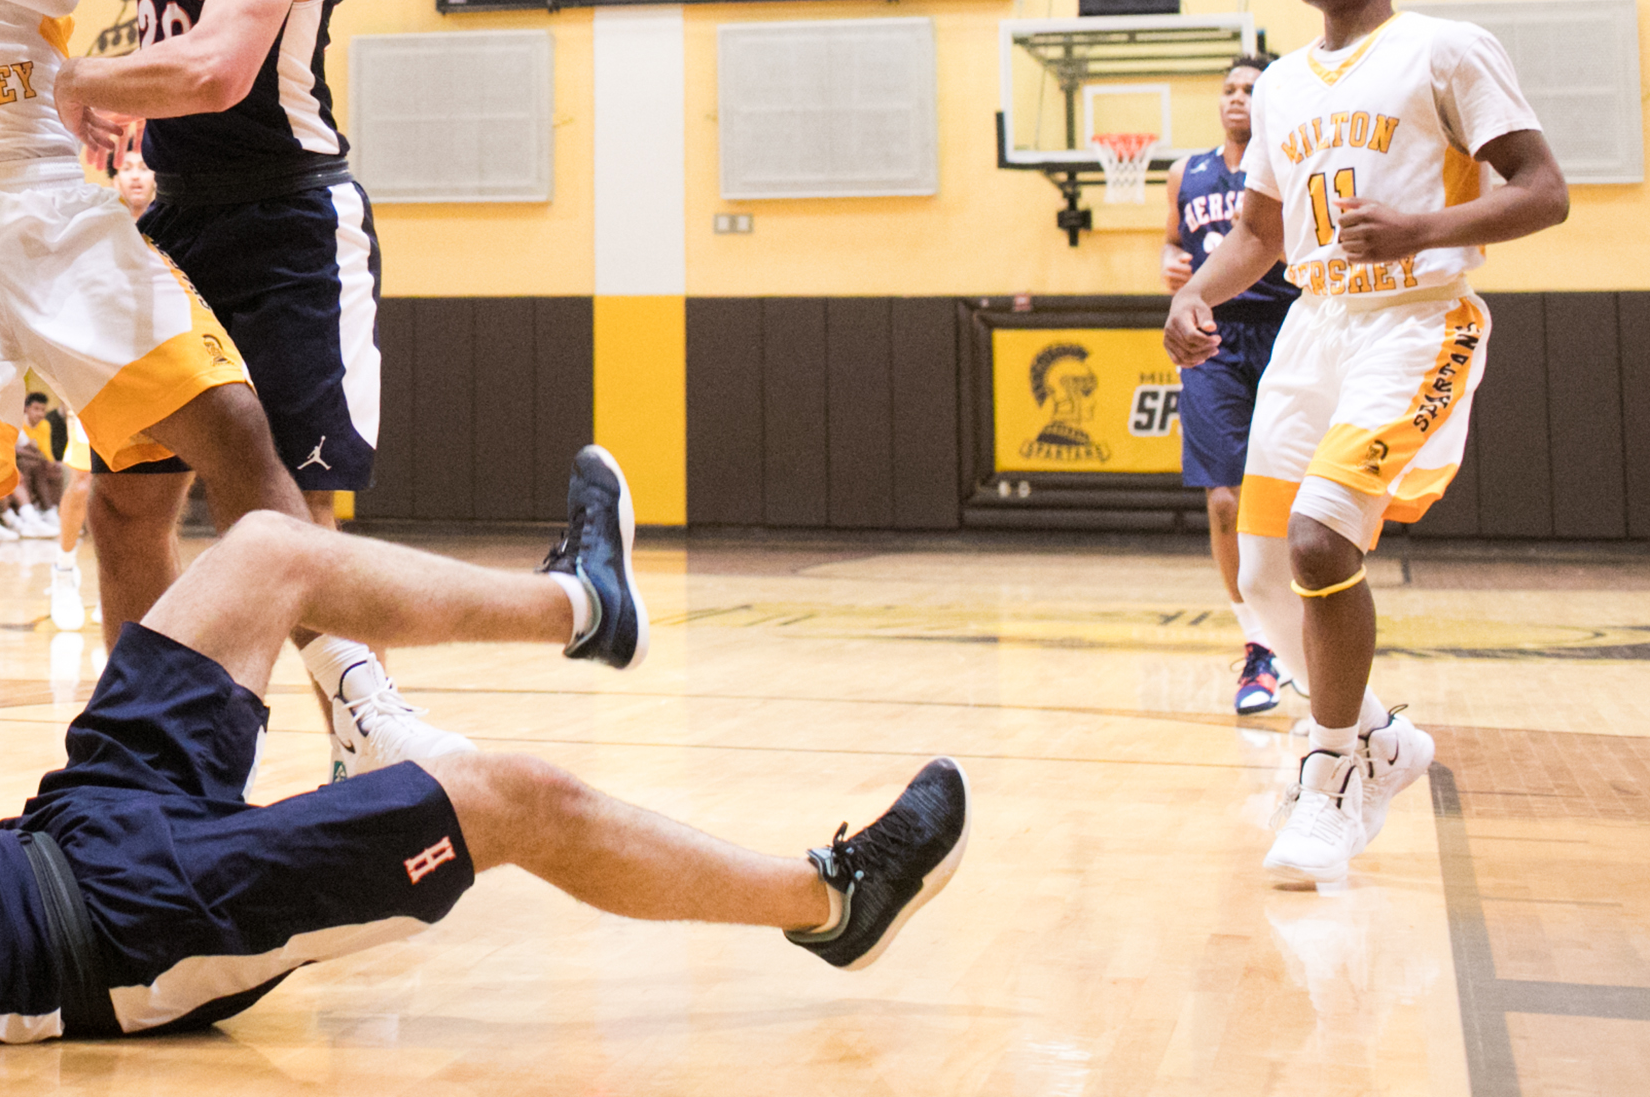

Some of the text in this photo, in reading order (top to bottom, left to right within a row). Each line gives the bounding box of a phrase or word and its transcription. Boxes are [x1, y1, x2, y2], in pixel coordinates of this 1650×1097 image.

[1281, 110, 1400, 165] MILTON
[1287, 254, 1418, 296] ERSHEY
[1139, 371, 1179, 384] MIL
[1131, 386, 1182, 434] SP
[403, 836, 456, 885] H
